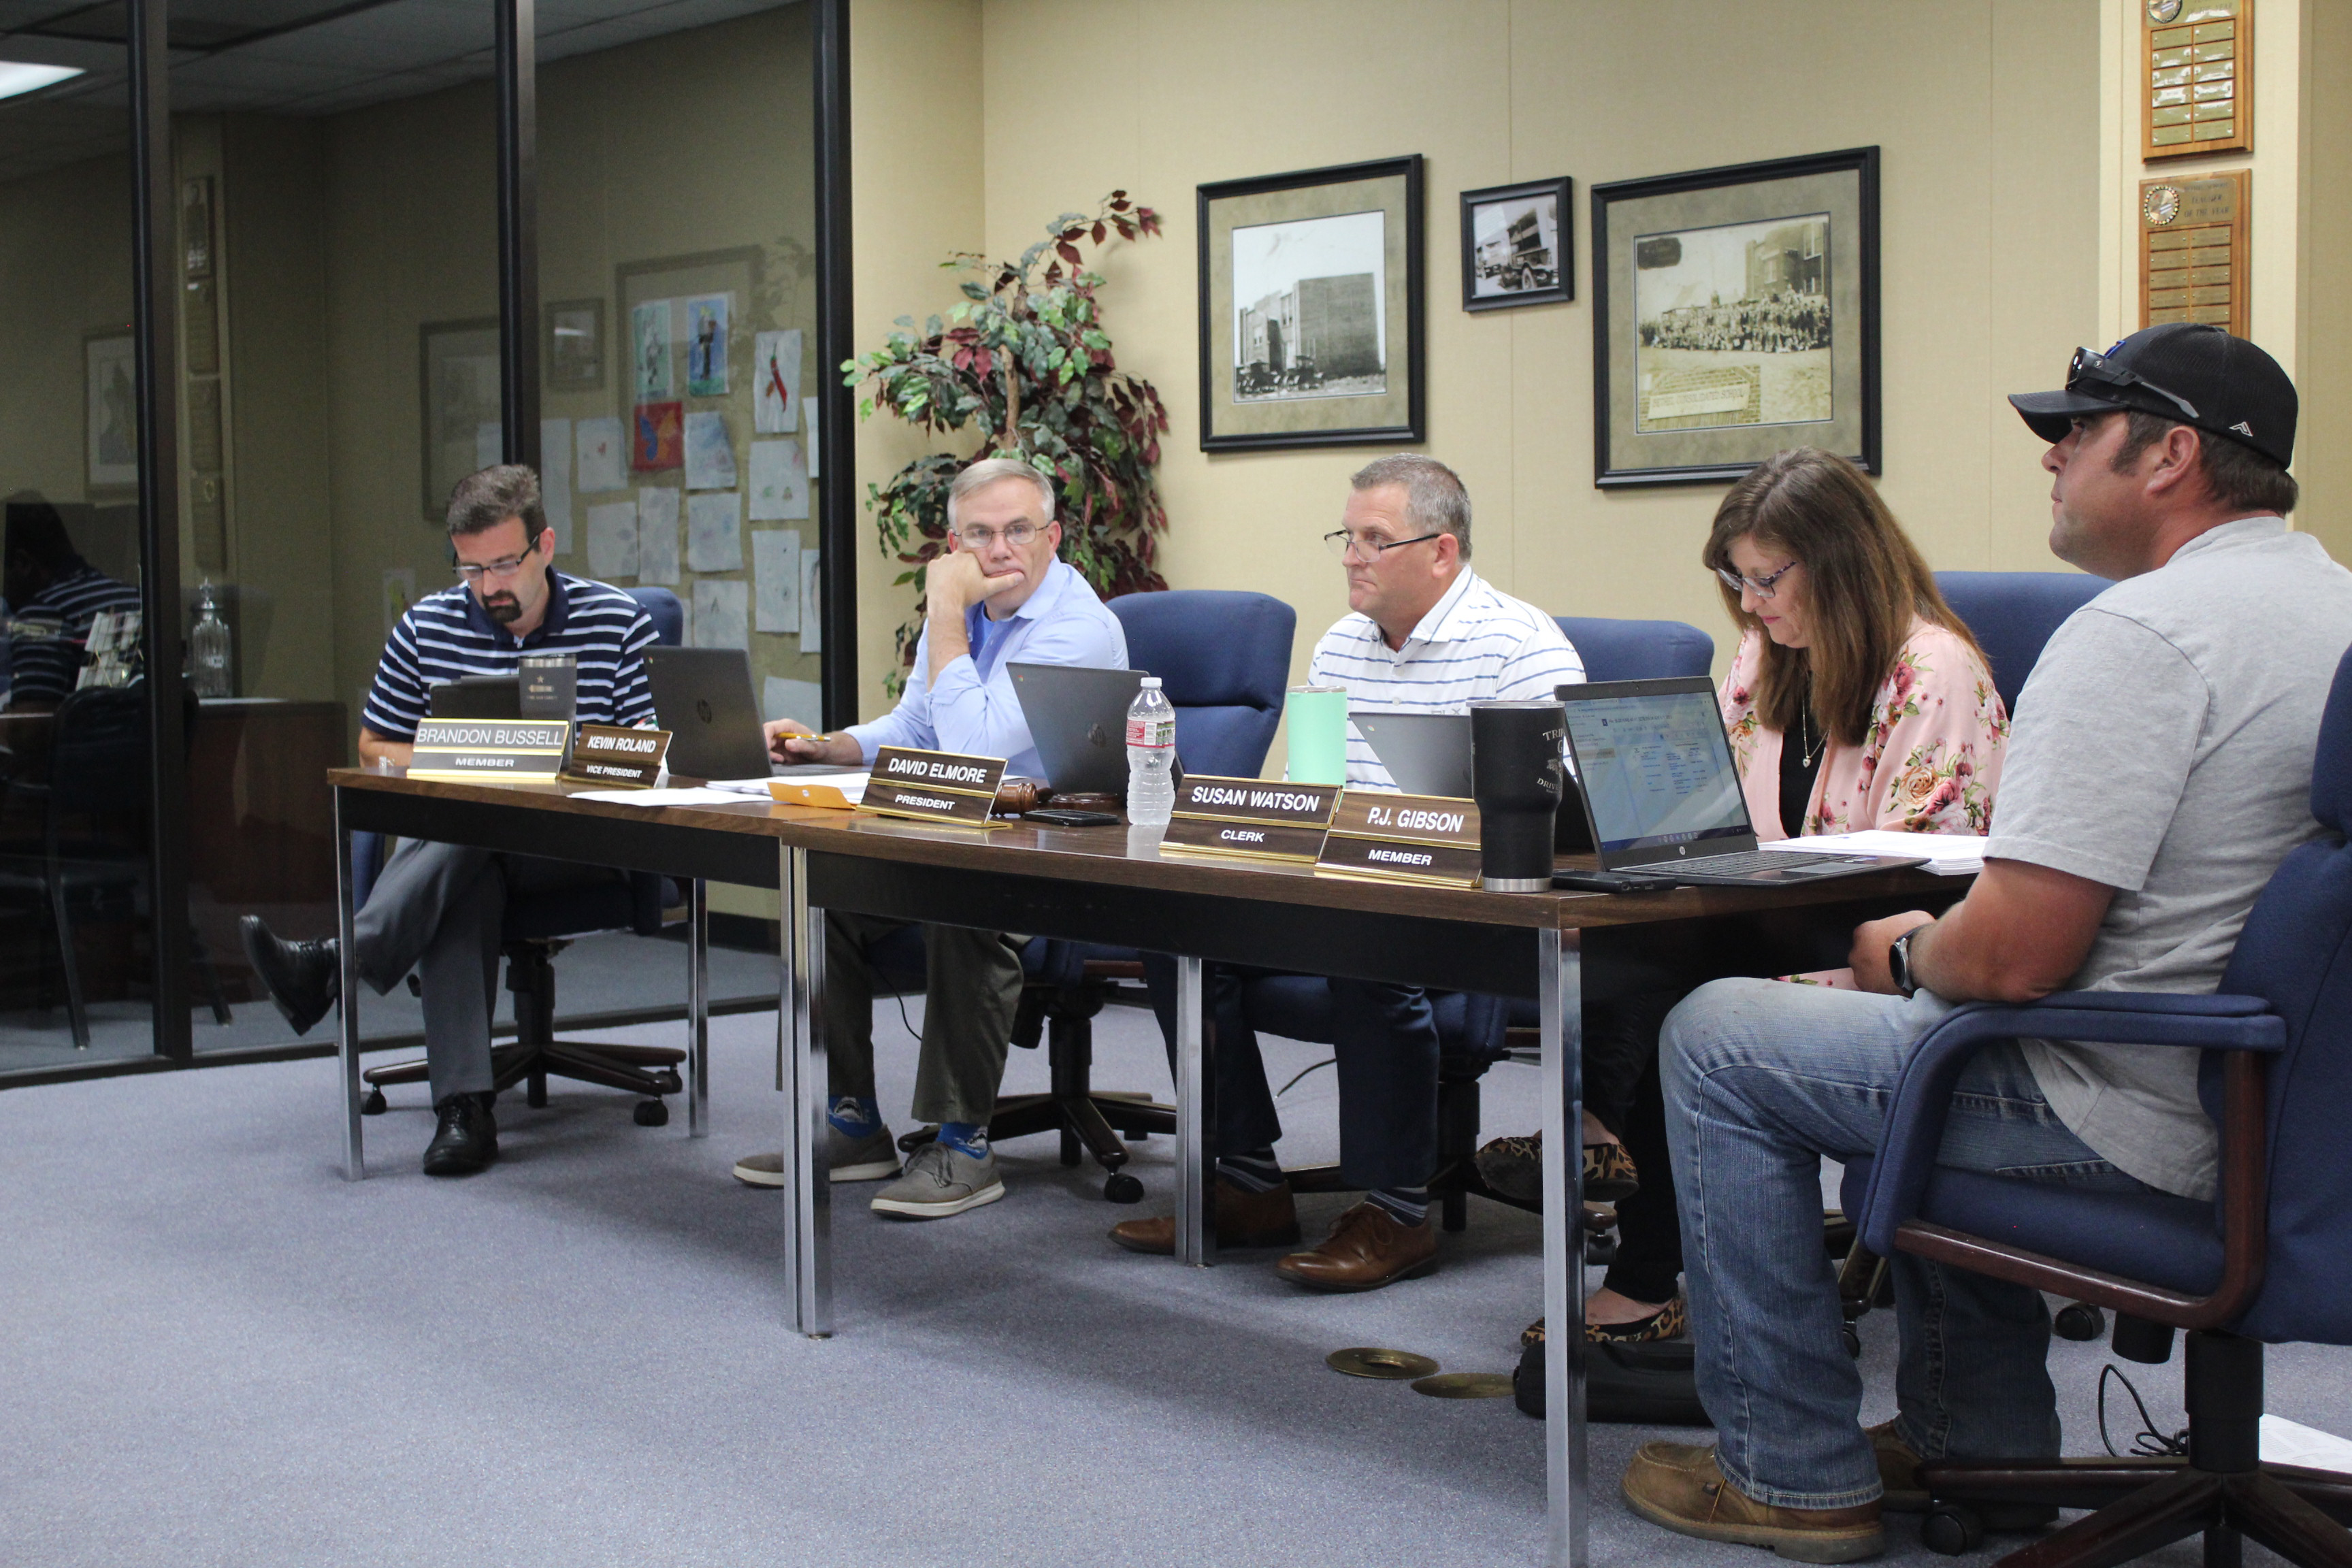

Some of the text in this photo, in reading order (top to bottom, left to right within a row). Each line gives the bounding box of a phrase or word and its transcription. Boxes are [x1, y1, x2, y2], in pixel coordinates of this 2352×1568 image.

[416, 728, 562, 745] BRANDON BUSSELL
[587, 735, 657, 753] KEVIN ROLAND
[455, 757, 514, 767] MEMBER
[887, 757, 987, 783] DAVID ELMORE
[586, 764, 642, 779] VICE PRESIDENT
[895, 794, 956, 811] PRESIDENT
[1191, 785, 1320, 812] SUSAN WATSON
[1367, 806, 1464, 832] P.J. GIBSON
[1220, 829, 1265, 843] CLERK
[1368, 849, 1433, 866] MEMBER
